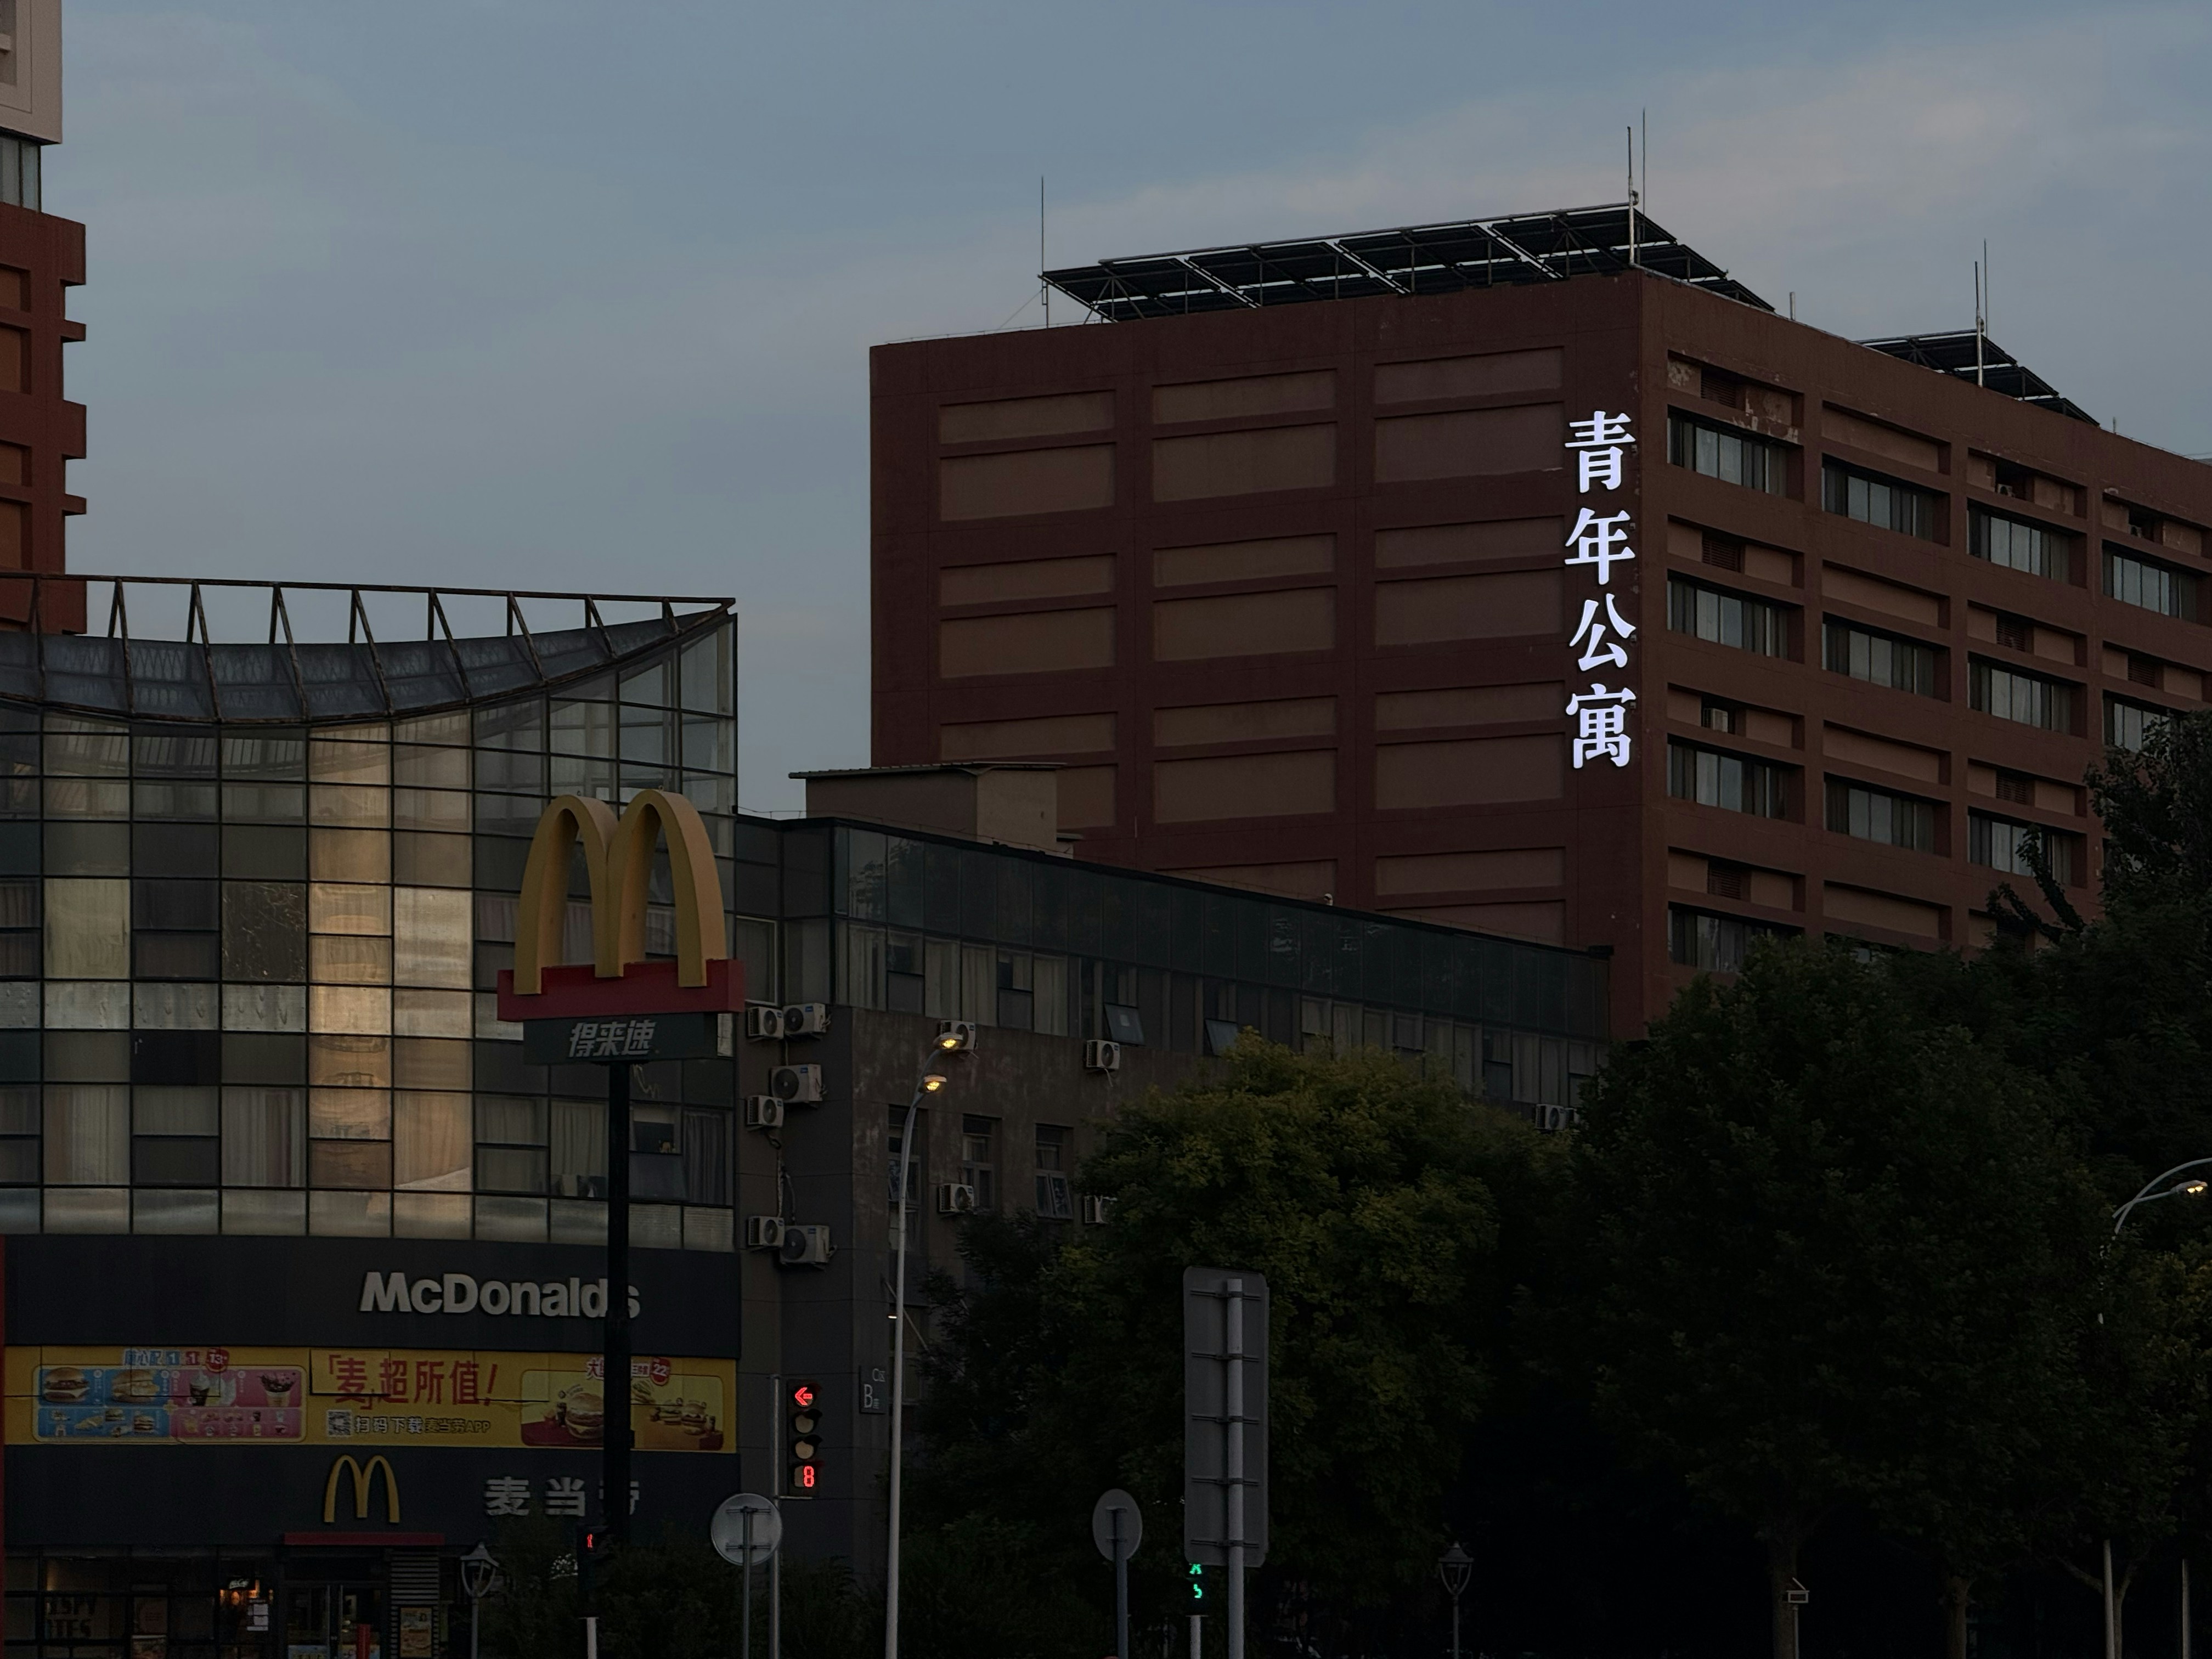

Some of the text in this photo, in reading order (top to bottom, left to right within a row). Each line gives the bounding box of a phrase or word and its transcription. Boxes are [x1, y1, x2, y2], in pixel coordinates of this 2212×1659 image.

[1564, 410, 1637, 769] 青年公寓
[568, 1019, 657, 1058] 得来速
[803, 1465, 815, 1488] 8
